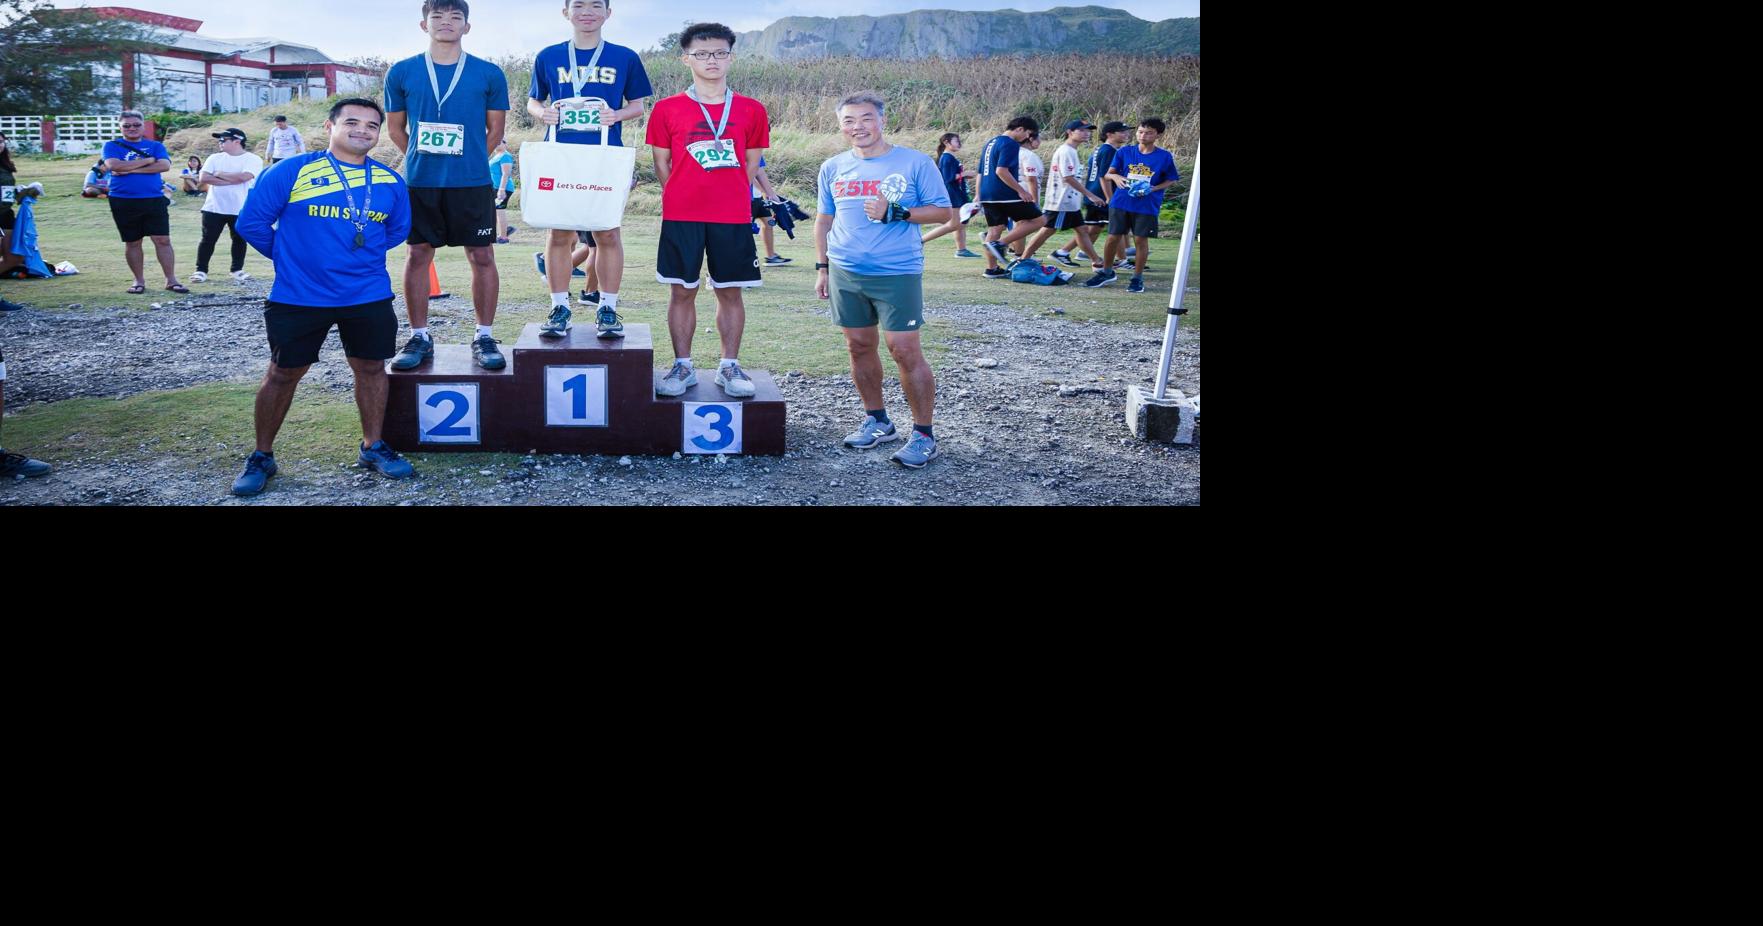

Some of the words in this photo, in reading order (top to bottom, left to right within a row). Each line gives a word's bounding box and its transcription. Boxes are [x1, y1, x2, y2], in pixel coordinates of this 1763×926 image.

[557, 66, 617, 85] MHS
[565, 110, 601, 125] 352
[420, 131, 457, 147] 267
[695, 149, 733, 165] 292
[557, 182, 574, 190] Let's
[589, 184, 613, 192] Places
[308, 204, 340, 218] RUN
[563, 374, 588, 420] 1
[425, 390, 471, 436] 2
[691, 404, 735, 451] 3
